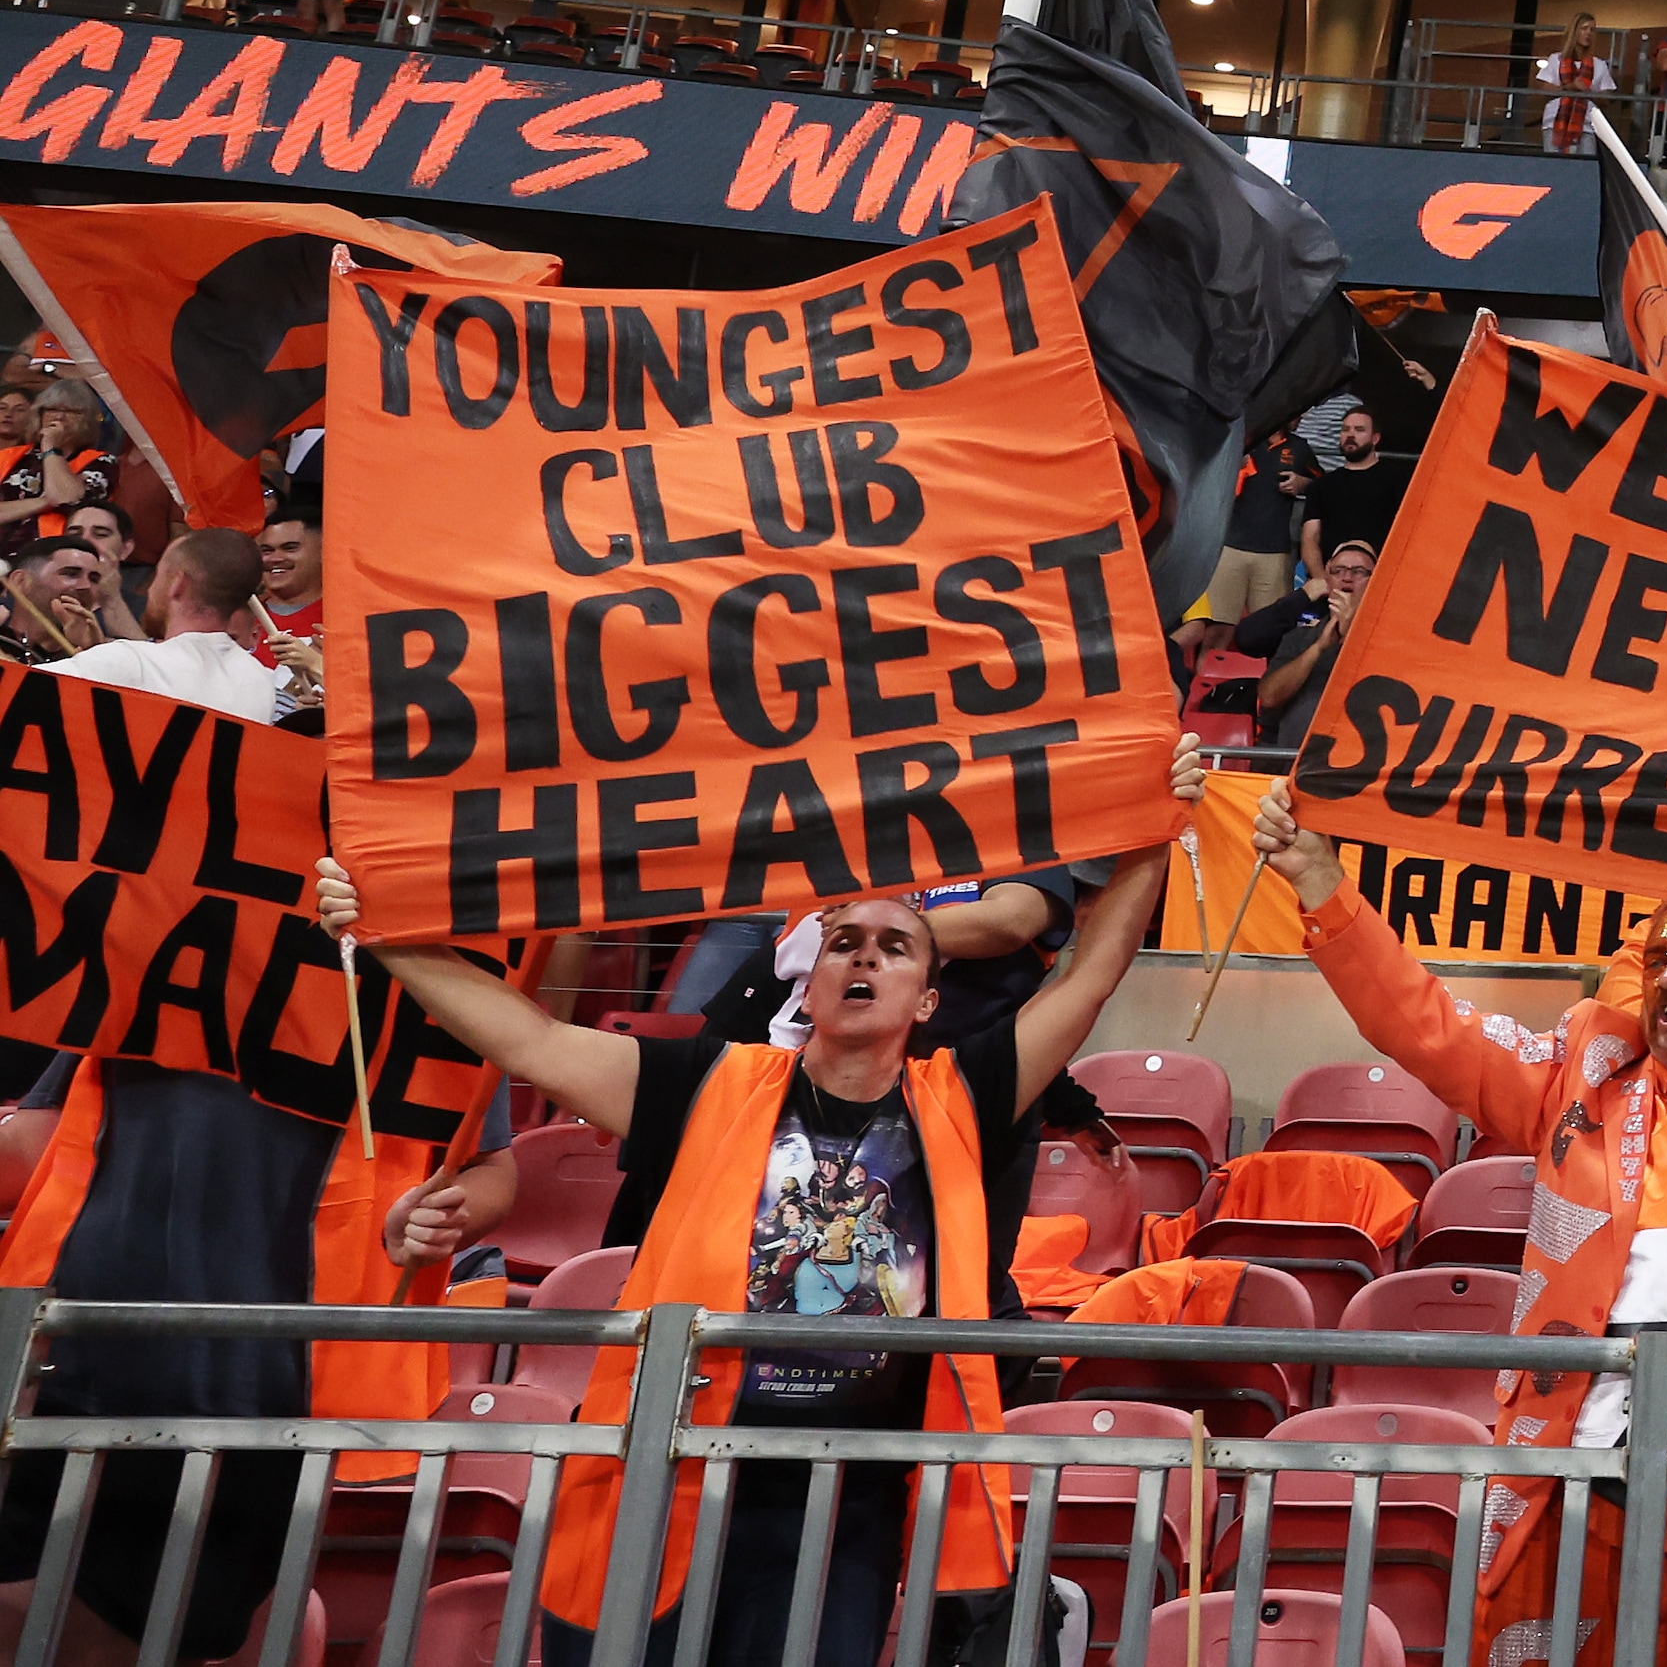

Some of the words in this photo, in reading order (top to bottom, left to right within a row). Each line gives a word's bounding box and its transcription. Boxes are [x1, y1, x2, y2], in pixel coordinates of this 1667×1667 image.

[0, 20, 664, 198] GIANTS
[355, 221, 1039, 433] YOUNGEST
[540, 418, 927, 578] CLUB
[365, 521, 1121, 781] BIGGEST
[0, 667, 332, 908] AYL
[449, 718, 1079, 935] HEART
[929, 880, 979, 899] TIRES
[758, 1366, 874, 1379] ENDTIMES
